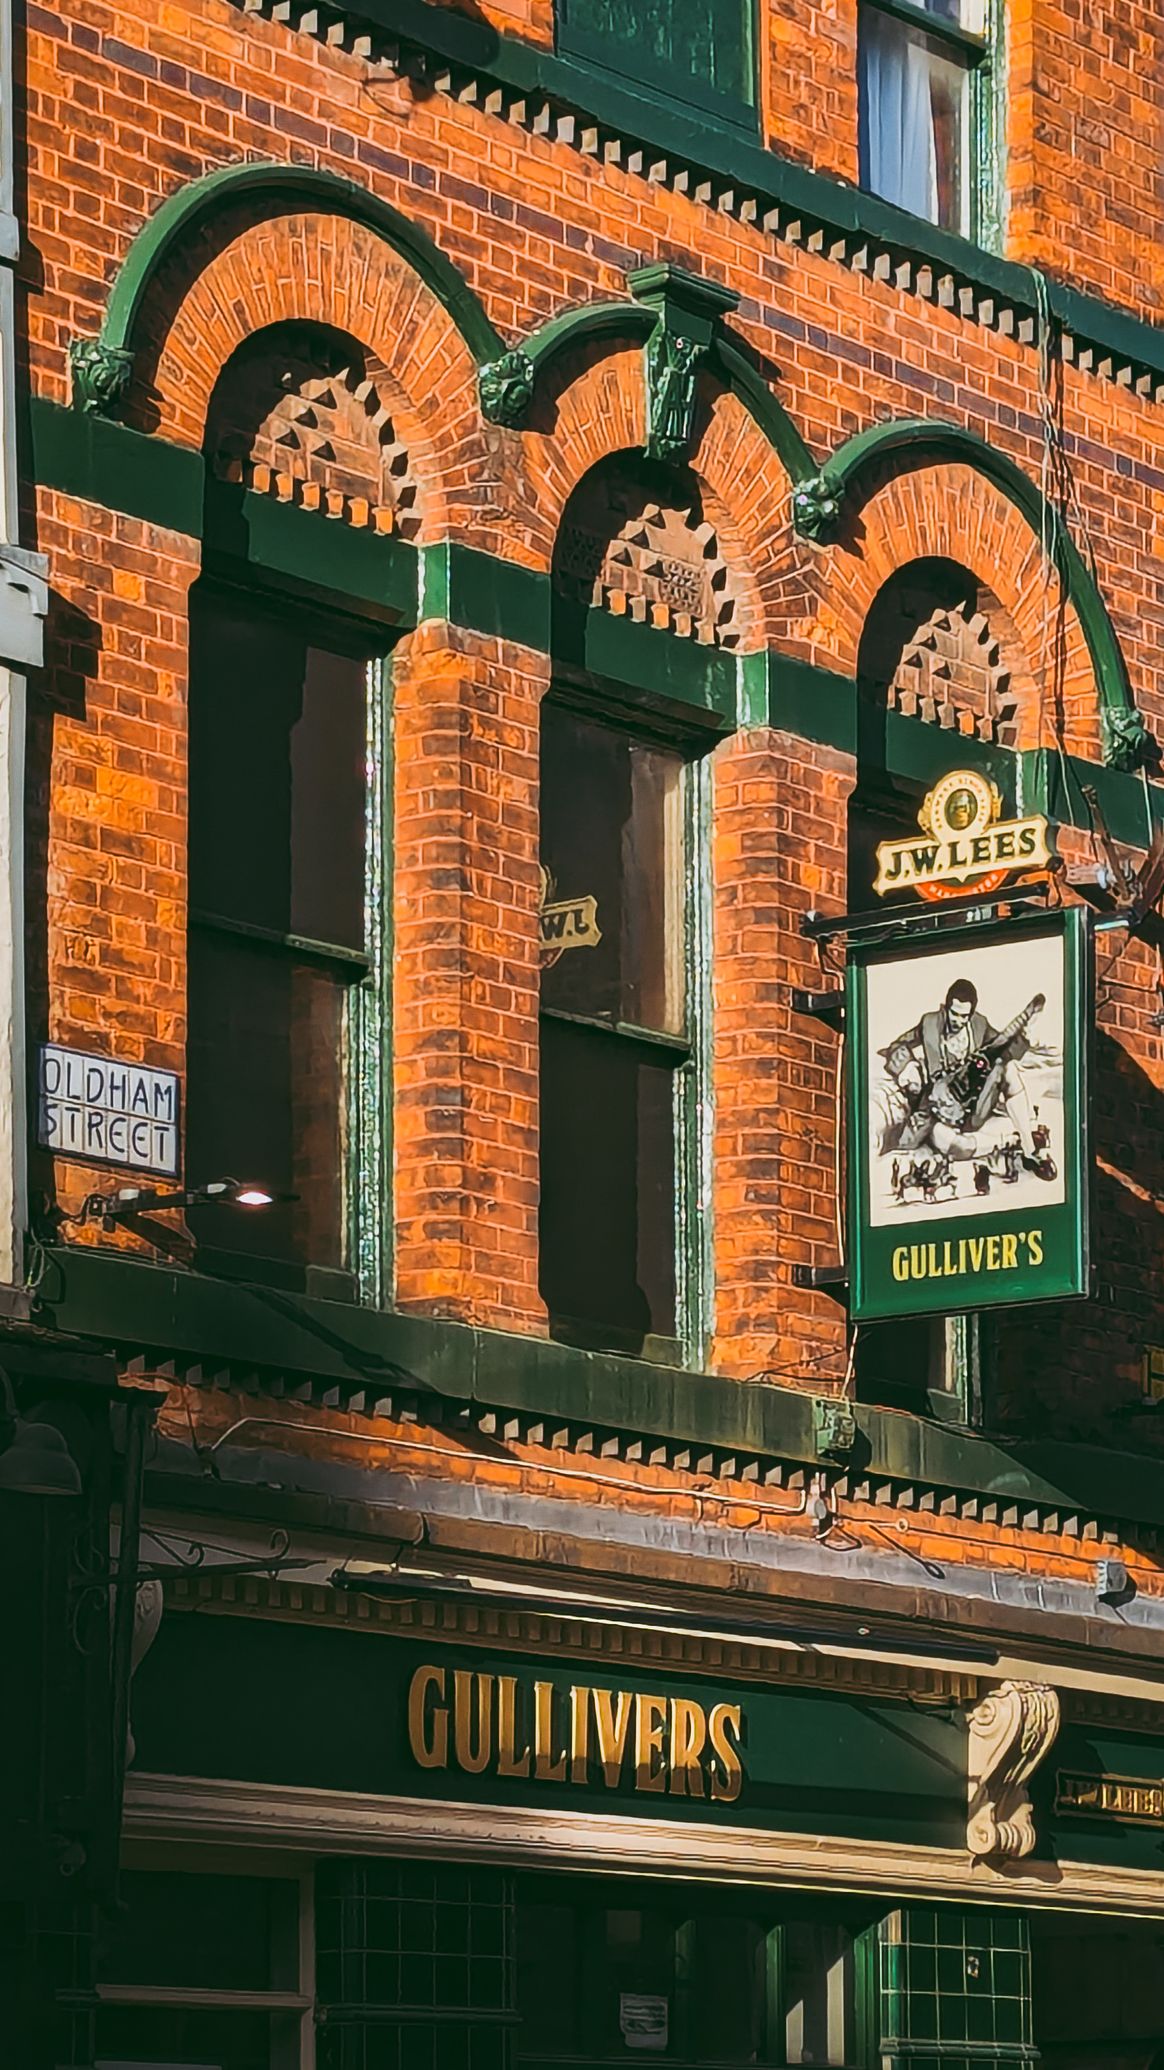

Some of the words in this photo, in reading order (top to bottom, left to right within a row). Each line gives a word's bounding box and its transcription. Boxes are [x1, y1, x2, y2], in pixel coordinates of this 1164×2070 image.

[43, 1058, 173, 1121] OLDHAM
[45, 1103, 170, 1163] STREET
[892, 1230, 1044, 1282] GULLIVER'S
[408, 1664, 743, 1801] GULLIVERS
